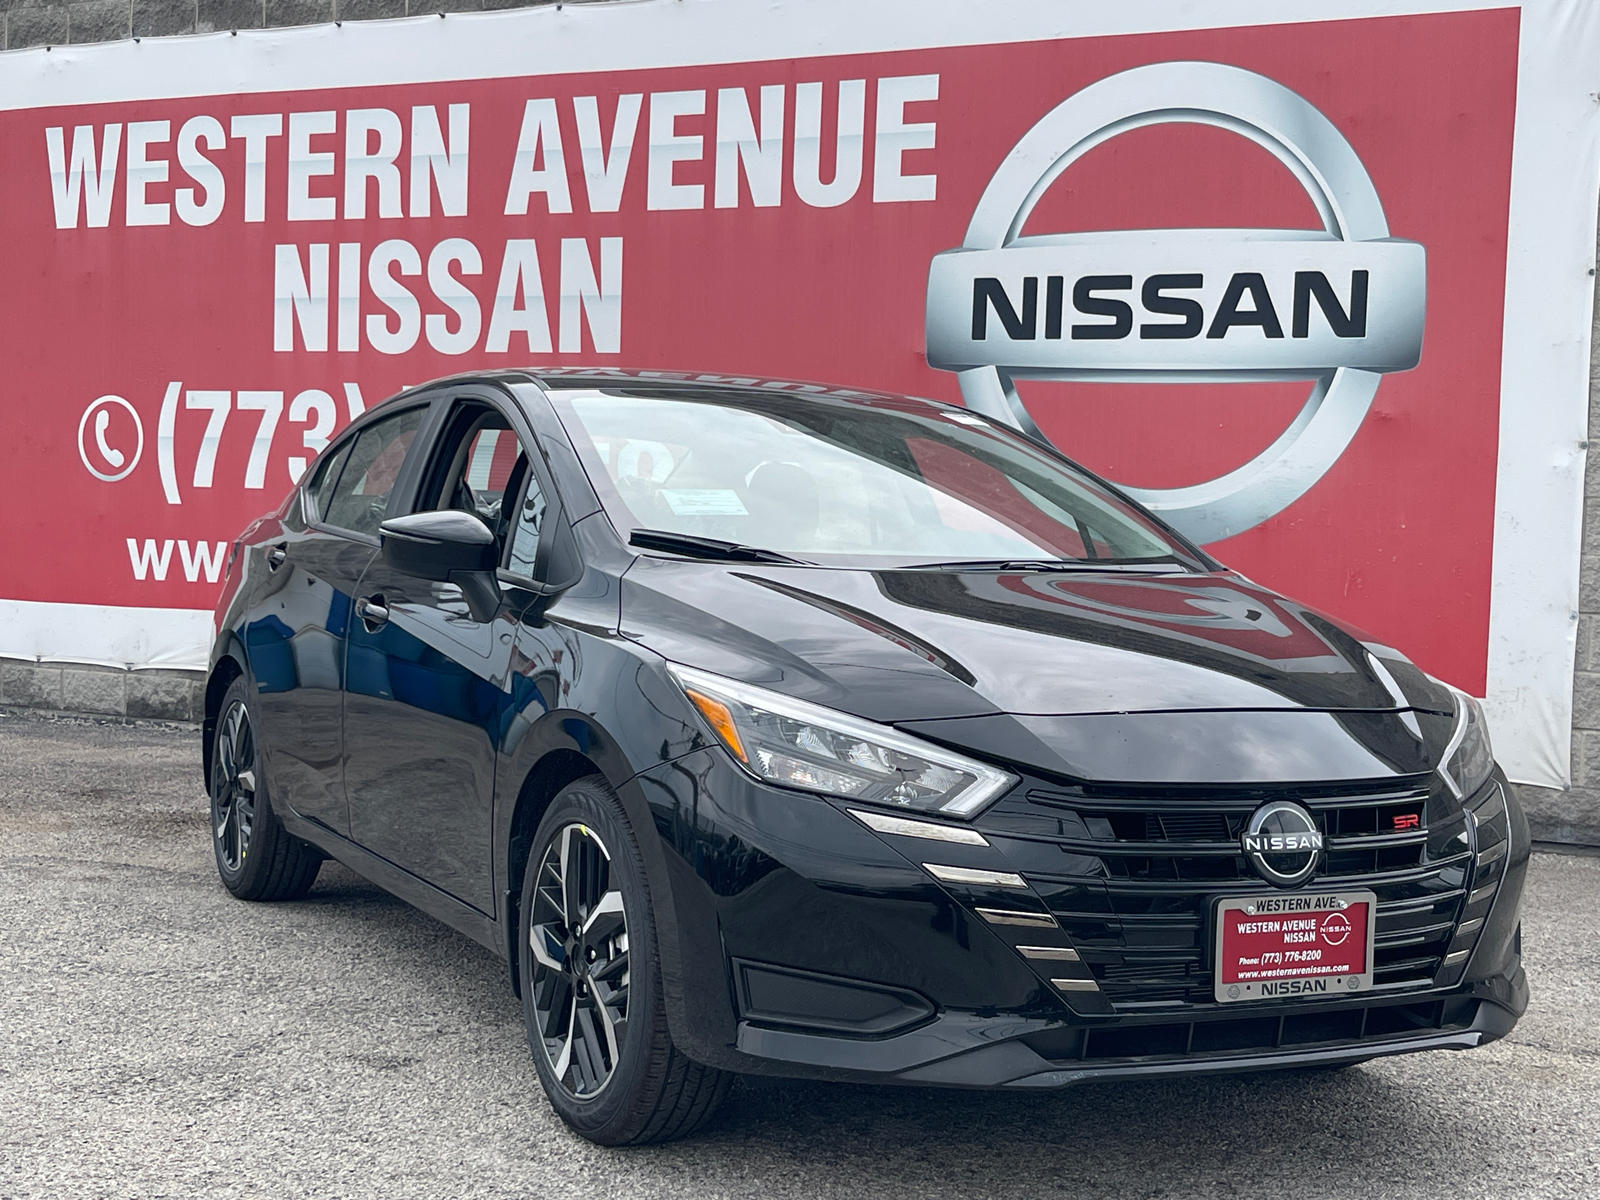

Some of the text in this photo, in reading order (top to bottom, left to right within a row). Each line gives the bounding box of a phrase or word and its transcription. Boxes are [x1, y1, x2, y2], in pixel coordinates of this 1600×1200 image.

[45, 74, 940, 230] WESTERN AVENUE
[273, 237, 624, 355] NISSAN
[970, 269, 1370, 342] NISSAN
[1393, 813, 1419, 830] SR
[1246, 835, 1322, 851] NISSAN
[1256, 897, 1311, 912] WESTERN
[1237, 919, 1316, 934] WESTERN AVENUE
[1319, 925, 1352, 933] NISSAN
[1283, 931, 1316, 944] NISSAN
[1238, 949, 1322, 966] Phone: (773) 776-8200
[1238, 964, 1350, 979] www.westernavenissan.com
[1261, 979, 1327, 996] NISSAN
